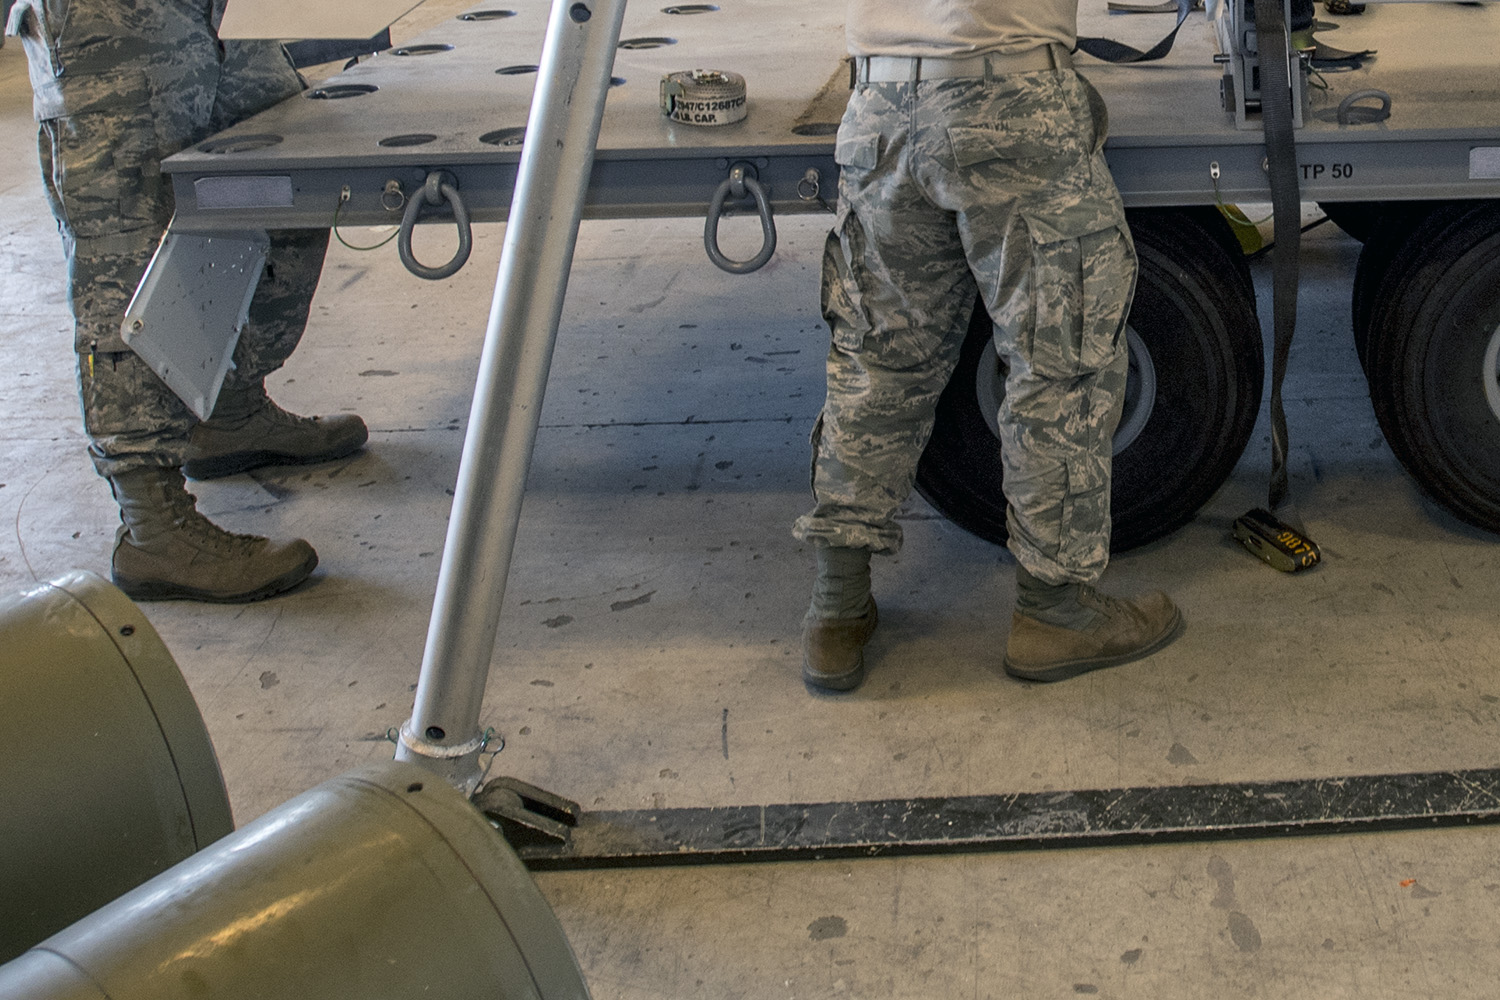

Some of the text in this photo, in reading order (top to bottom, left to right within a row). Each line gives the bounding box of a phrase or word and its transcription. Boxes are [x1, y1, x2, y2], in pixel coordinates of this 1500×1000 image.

[694, 114, 717, 123] CAP.
[1300, 163, 1353, 180] TP 50
